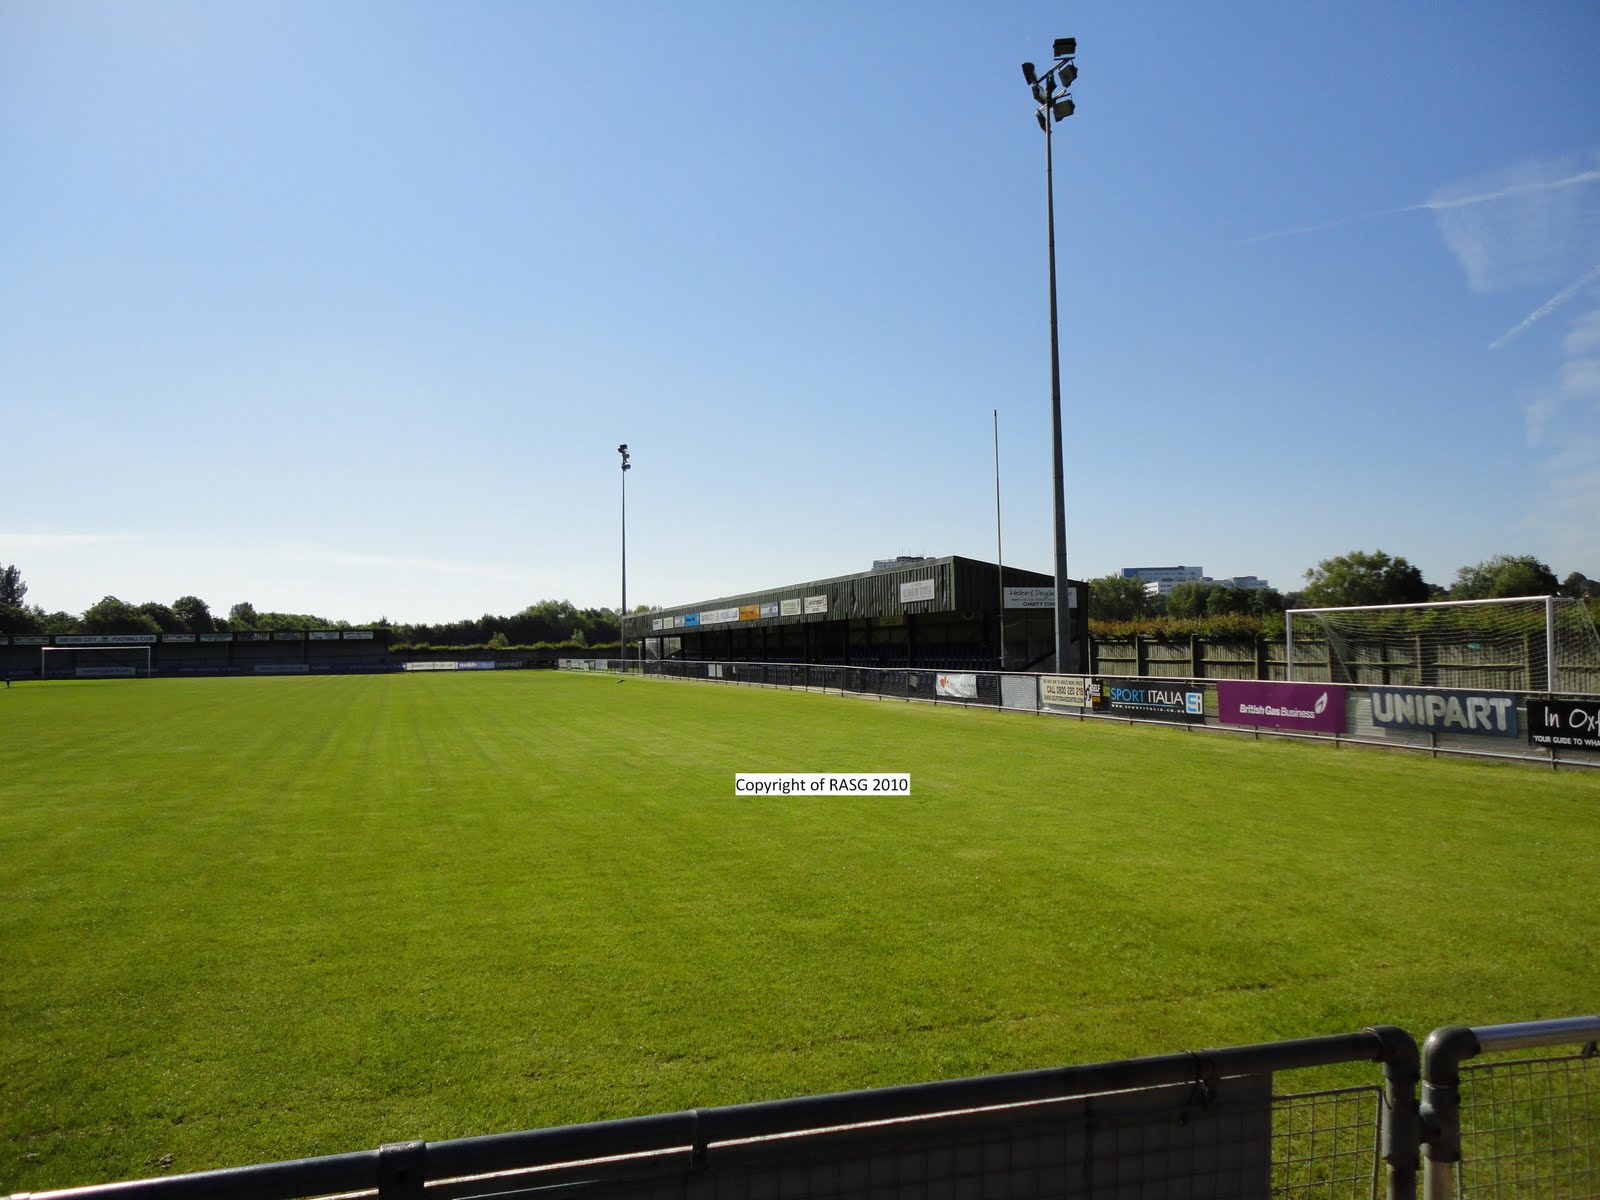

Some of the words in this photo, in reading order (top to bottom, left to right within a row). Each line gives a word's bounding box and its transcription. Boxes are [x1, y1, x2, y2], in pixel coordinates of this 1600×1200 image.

[1035, 589, 1056, 599] Dougla
[1047, 685, 1056, 694] CALL
[1056, 686, 1066, 694] 0800
[1067, 687, 1075, 695] 220
[1110, 687, 1145, 703] SPORT
[1147, 689, 1184, 705] ITALIA
[1239, 703, 1265, 716] British
[1265, 705, 1280, 717] Gas
[1280, 706, 1315, 719] Business
[1372, 692, 1512, 732] UNIPART
[1544, 706, 1560, 728] In
[1552, 736, 1572, 745] GUIDE
[1572, 738, 1583, 746] TO
